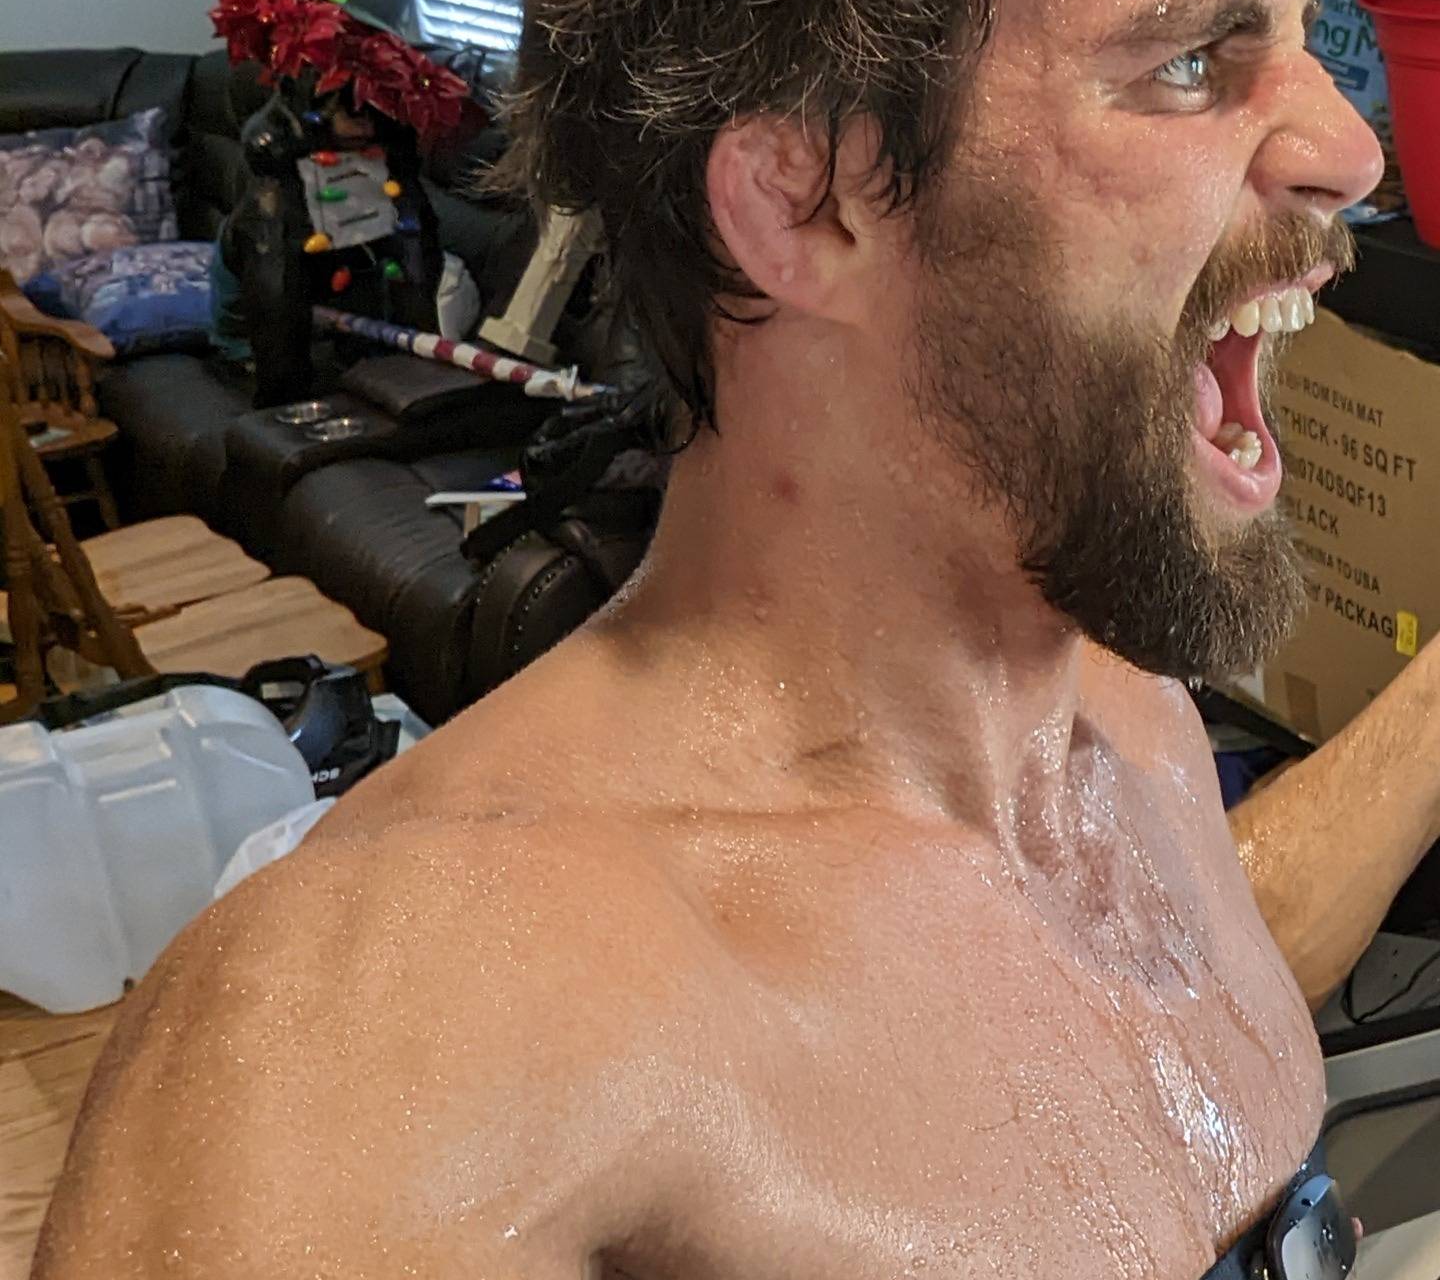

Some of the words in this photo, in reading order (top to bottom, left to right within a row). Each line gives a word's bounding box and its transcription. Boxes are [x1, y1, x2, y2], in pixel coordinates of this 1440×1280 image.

[1329, 387, 1355, 417] EVA
[1356, 401, 1384, 428] MAT
[1341, 433, 1358, 461] 96
[1363, 444, 1389, 476] SQ
[1392, 455, 1418, 483] FT
[1337, 558, 1351, 580] TO
[1354, 567, 1381, 595] USA
[1325, 587, 1397, 640] PACKAG
